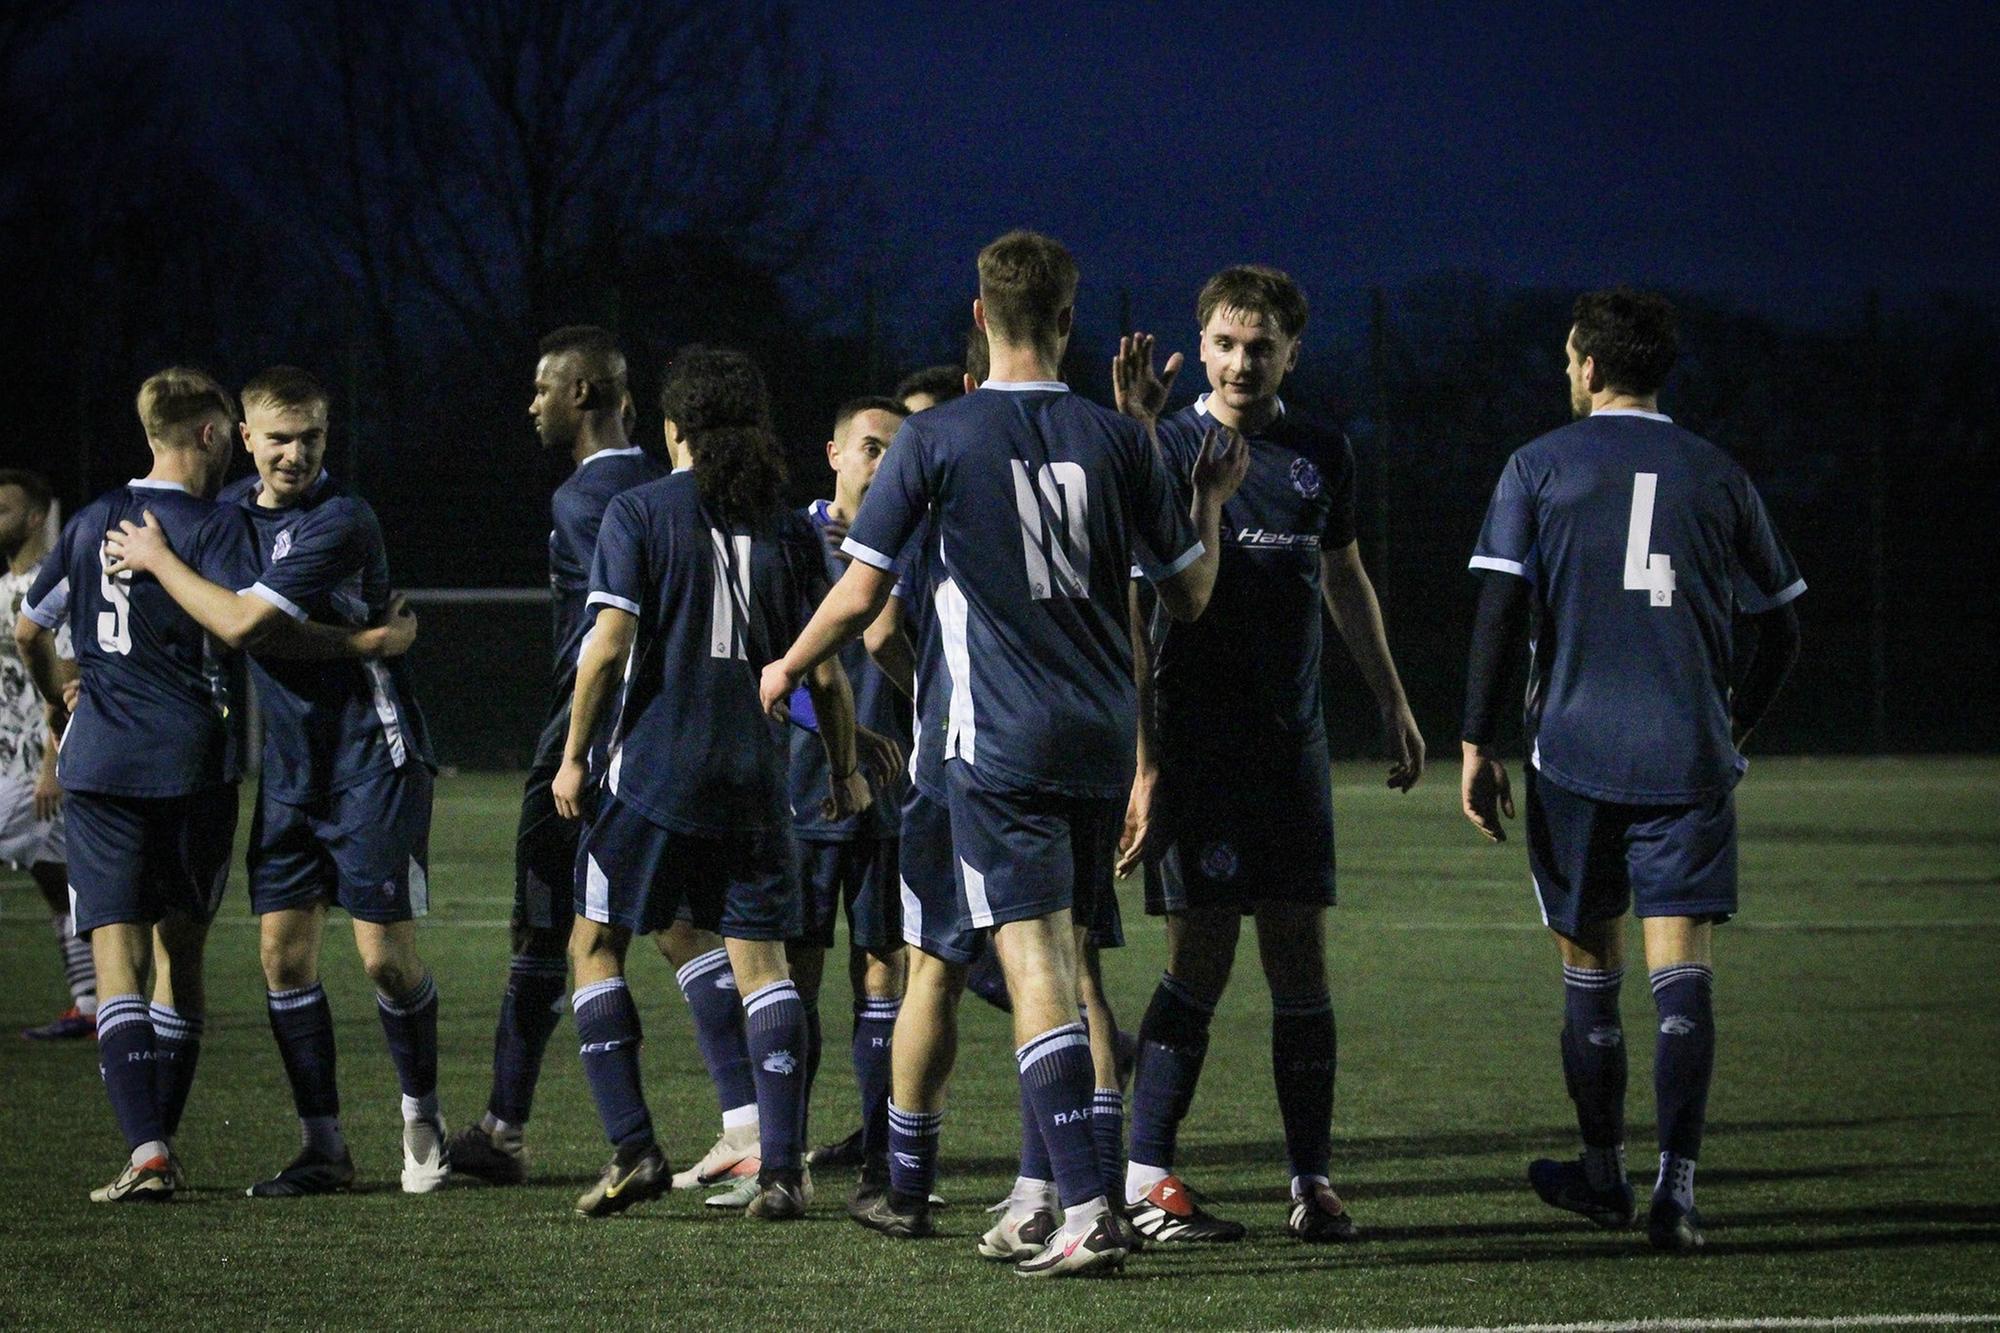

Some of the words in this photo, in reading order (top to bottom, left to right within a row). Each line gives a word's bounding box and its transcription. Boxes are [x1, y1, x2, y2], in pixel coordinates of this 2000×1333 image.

[1010, 458, 1091, 600] 10
[1624, 472, 1677, 607] 4
[1053, 1107, 1096, 1127] RAF
